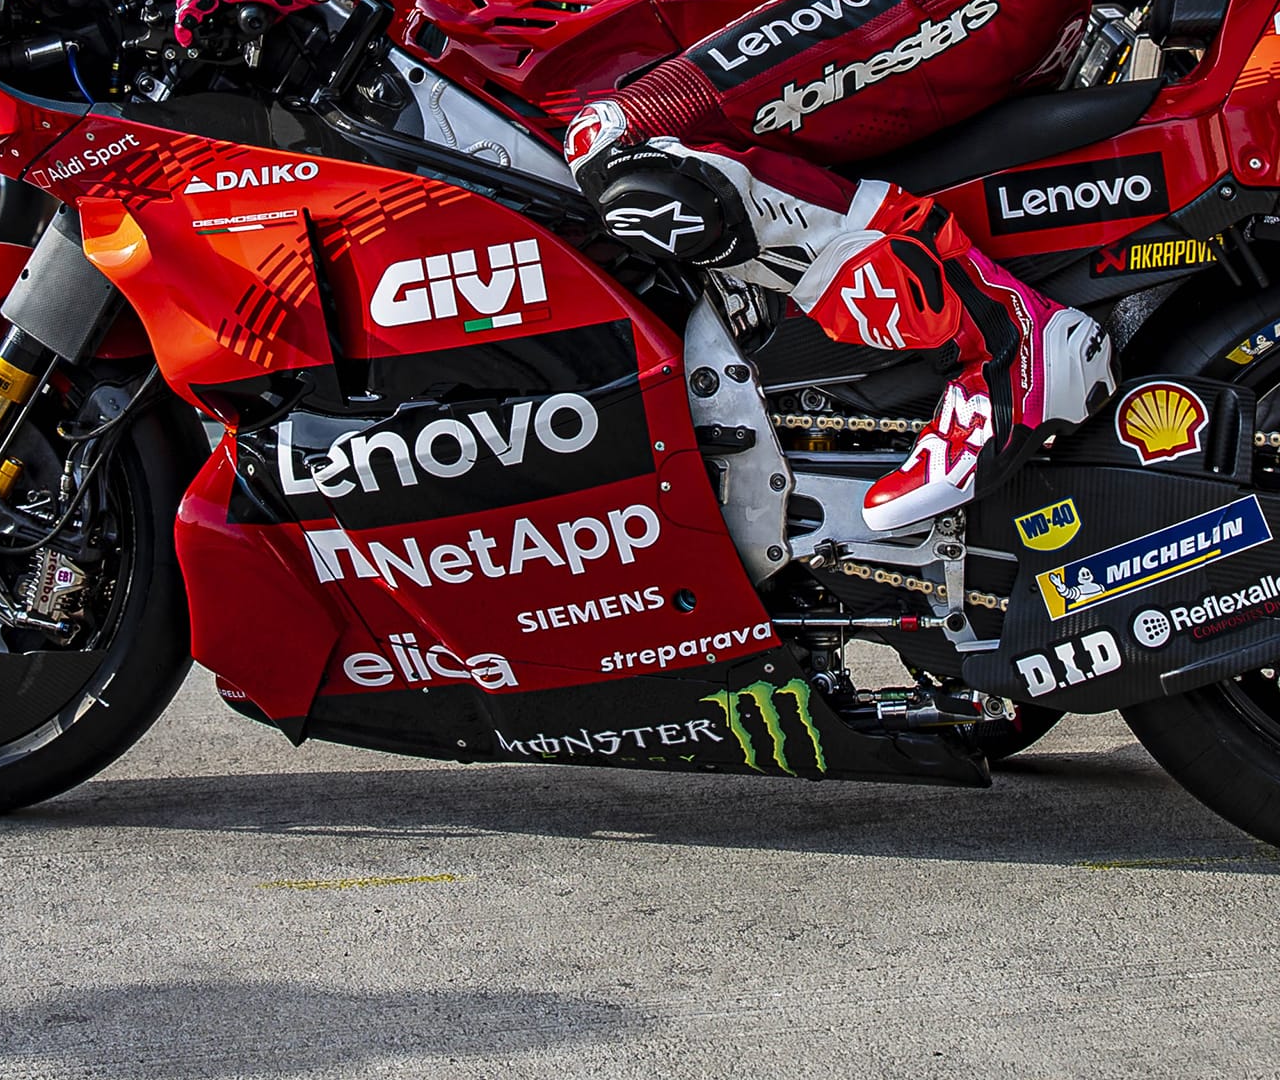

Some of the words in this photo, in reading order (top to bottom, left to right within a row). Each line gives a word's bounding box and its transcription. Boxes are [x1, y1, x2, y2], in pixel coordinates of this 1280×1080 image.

[47, 151, 86, 182] Audi
[84, 132, 140, 166] Sport
[216, 161, 320, 191] DAIKO
[192, 208, 298, 228] DESMOSEDICI
[998, 173, 1152, 222] Lenovo
[1130, 233, 1224, 271] AKRAPOVI
[369, 237, 549, 328] GIVI
[275, 392, 600, 499] Lenovo
[1020, 501, 1076, 540] WD-40
[368, 503, 662, 591] NetApp
[1105, 516, 1246, 586] MICHELIN
[516, 585, 666, 634] SIEMENS
[1192, 602, 1261, 640] COMPOSITES
[341, 632, 520, 691] elica
[599, 620, 773, 673] streparava
[219, 688, 246, 698] RELLI
[494, 718, 725, 757] MONSTER
